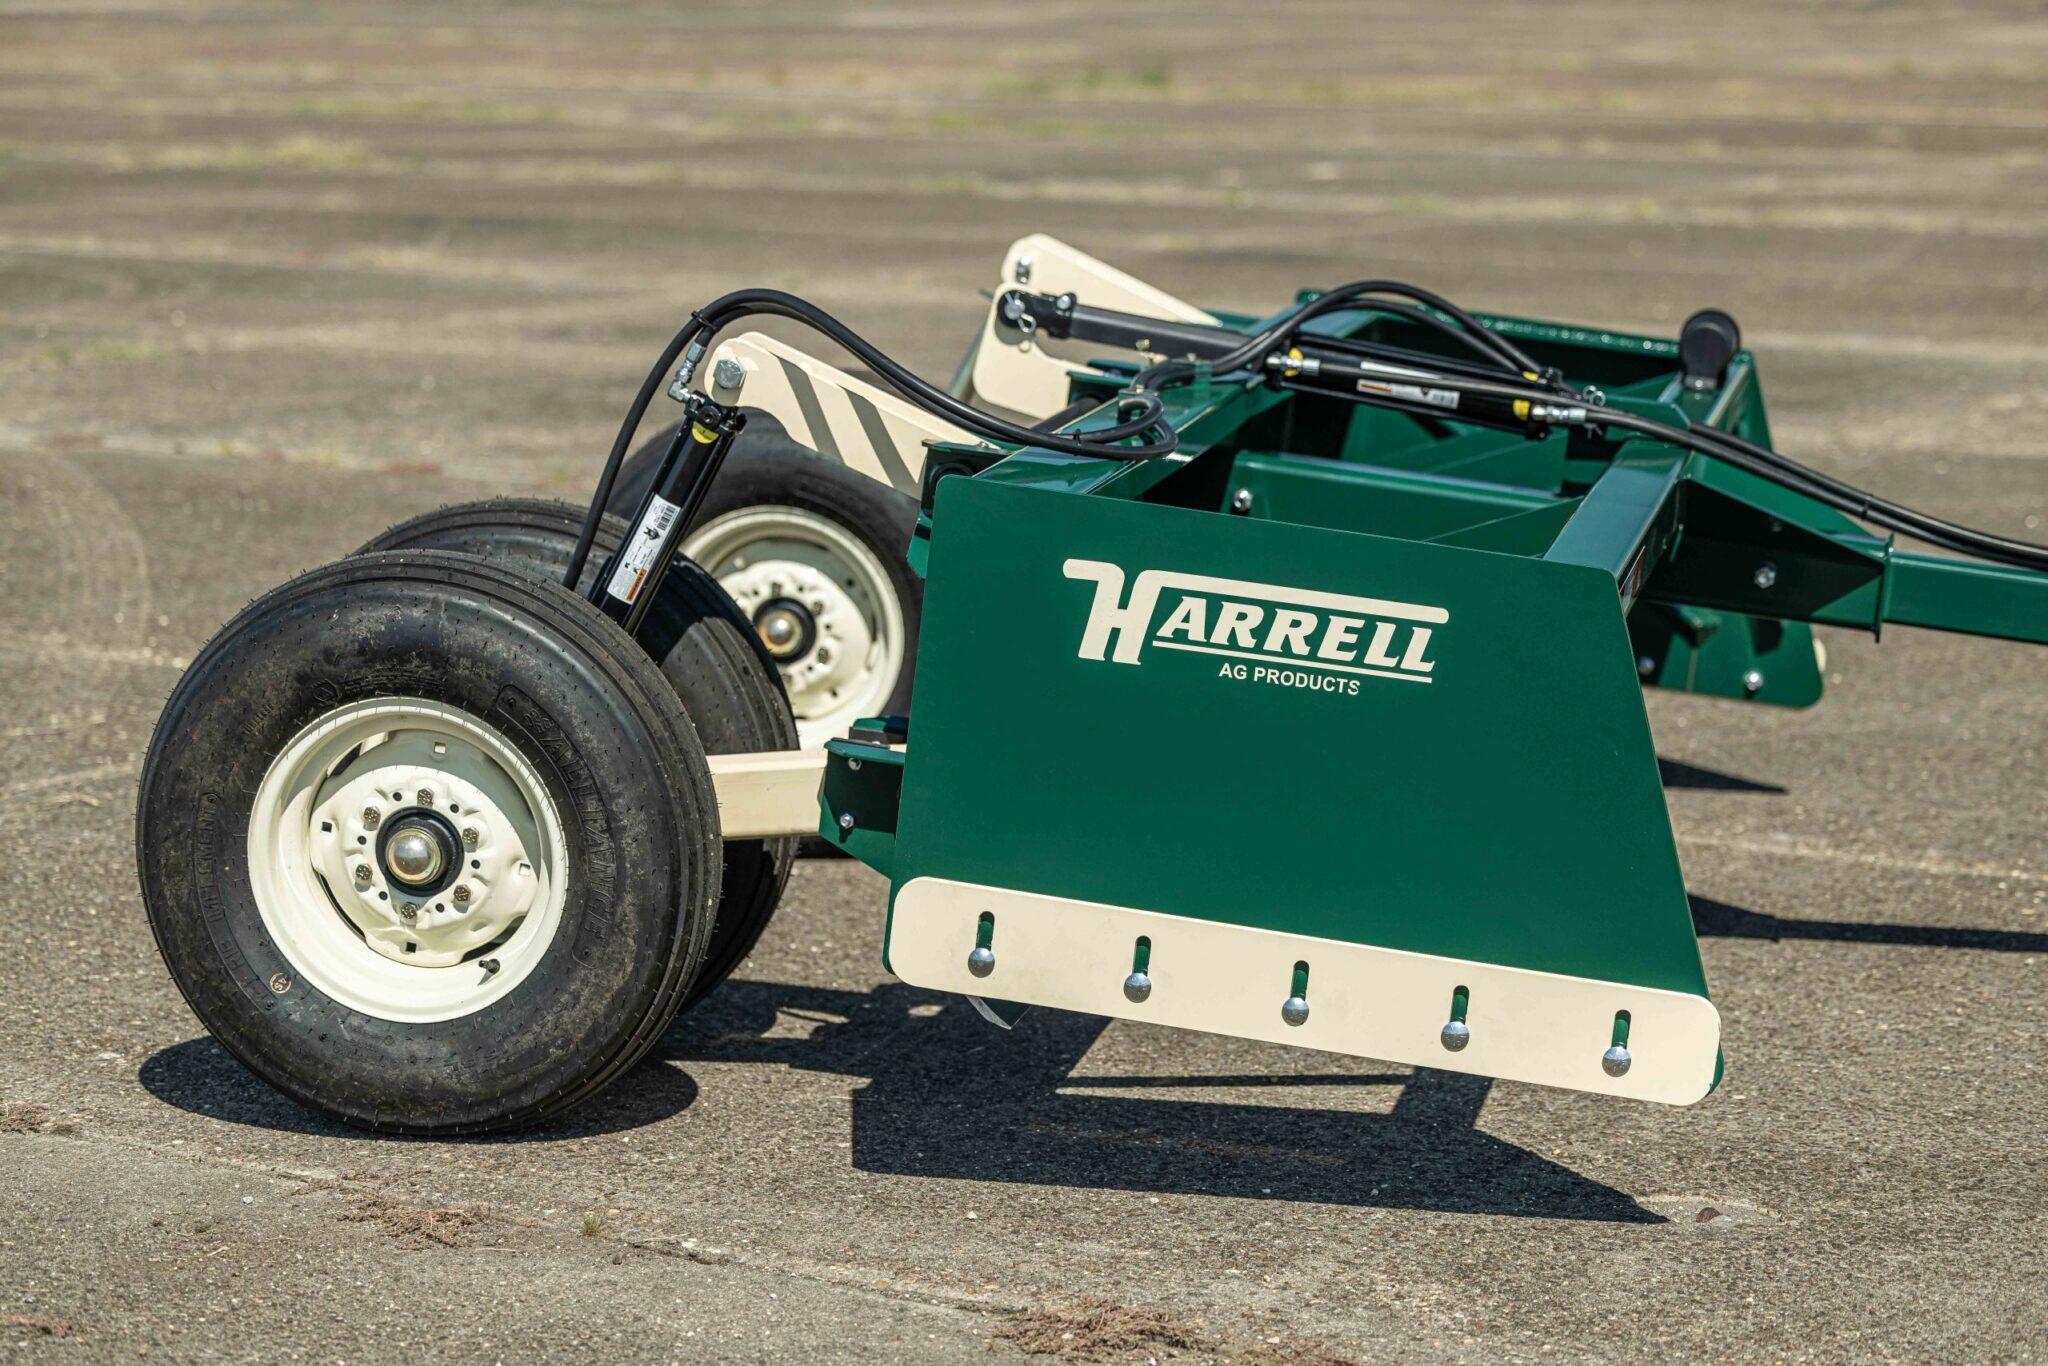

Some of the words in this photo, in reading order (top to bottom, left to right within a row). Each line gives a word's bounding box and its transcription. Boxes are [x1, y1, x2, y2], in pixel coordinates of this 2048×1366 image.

[1062, 558, 1450, 674] HARRELL
[1219, 663, 1247, 680] AG
[1253, 667, 1361, 696] PRODUCTS
[539, 731, 616, 940] ALLIANCE
